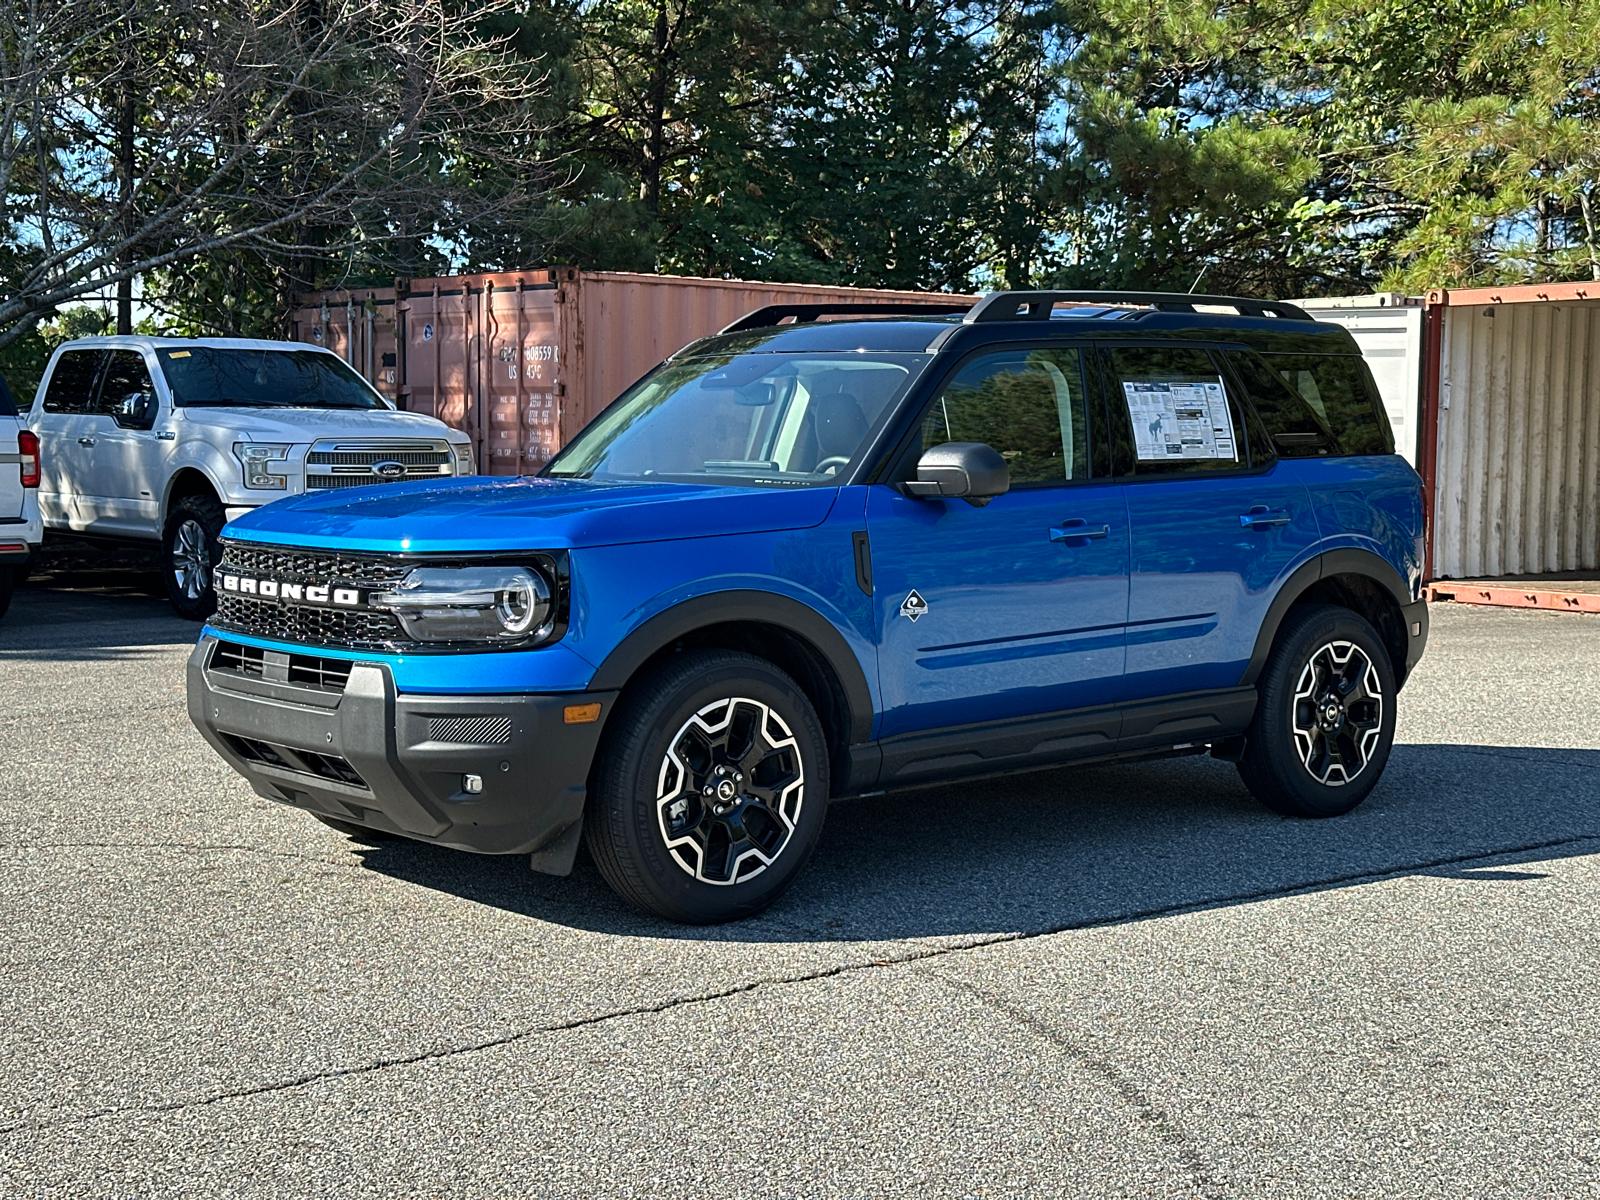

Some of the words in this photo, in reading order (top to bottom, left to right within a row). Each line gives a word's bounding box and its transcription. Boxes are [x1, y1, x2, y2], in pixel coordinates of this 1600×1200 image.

[386, 370, 395, 384] US
[508, 364, 518, 380] US
[382, 465, 400, 474] Ford
[223, 574, 359, 605] BRONCO
[638, 804, 665, 872] MICHELIN
